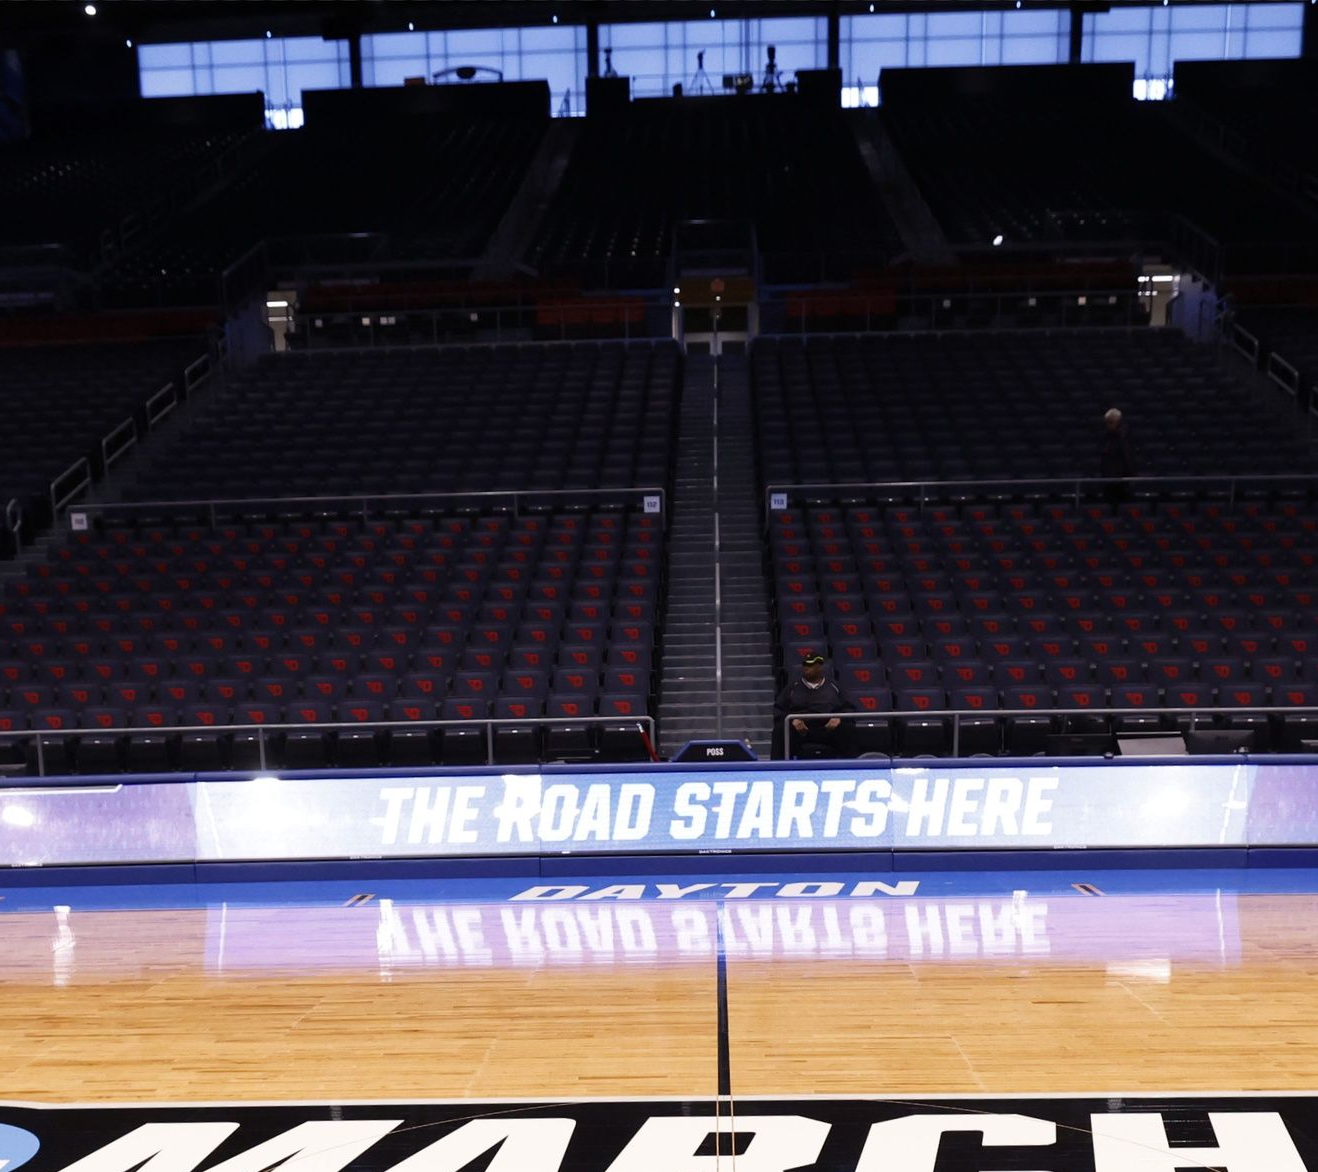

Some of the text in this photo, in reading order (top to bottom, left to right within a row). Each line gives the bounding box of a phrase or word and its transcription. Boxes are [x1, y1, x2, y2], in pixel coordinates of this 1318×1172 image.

[706, 747, 724, 756] POSS
[379, 777, 1059, 844] THE ROAD STARTS HERE
[507, 881, 920, 901] DAYTON
